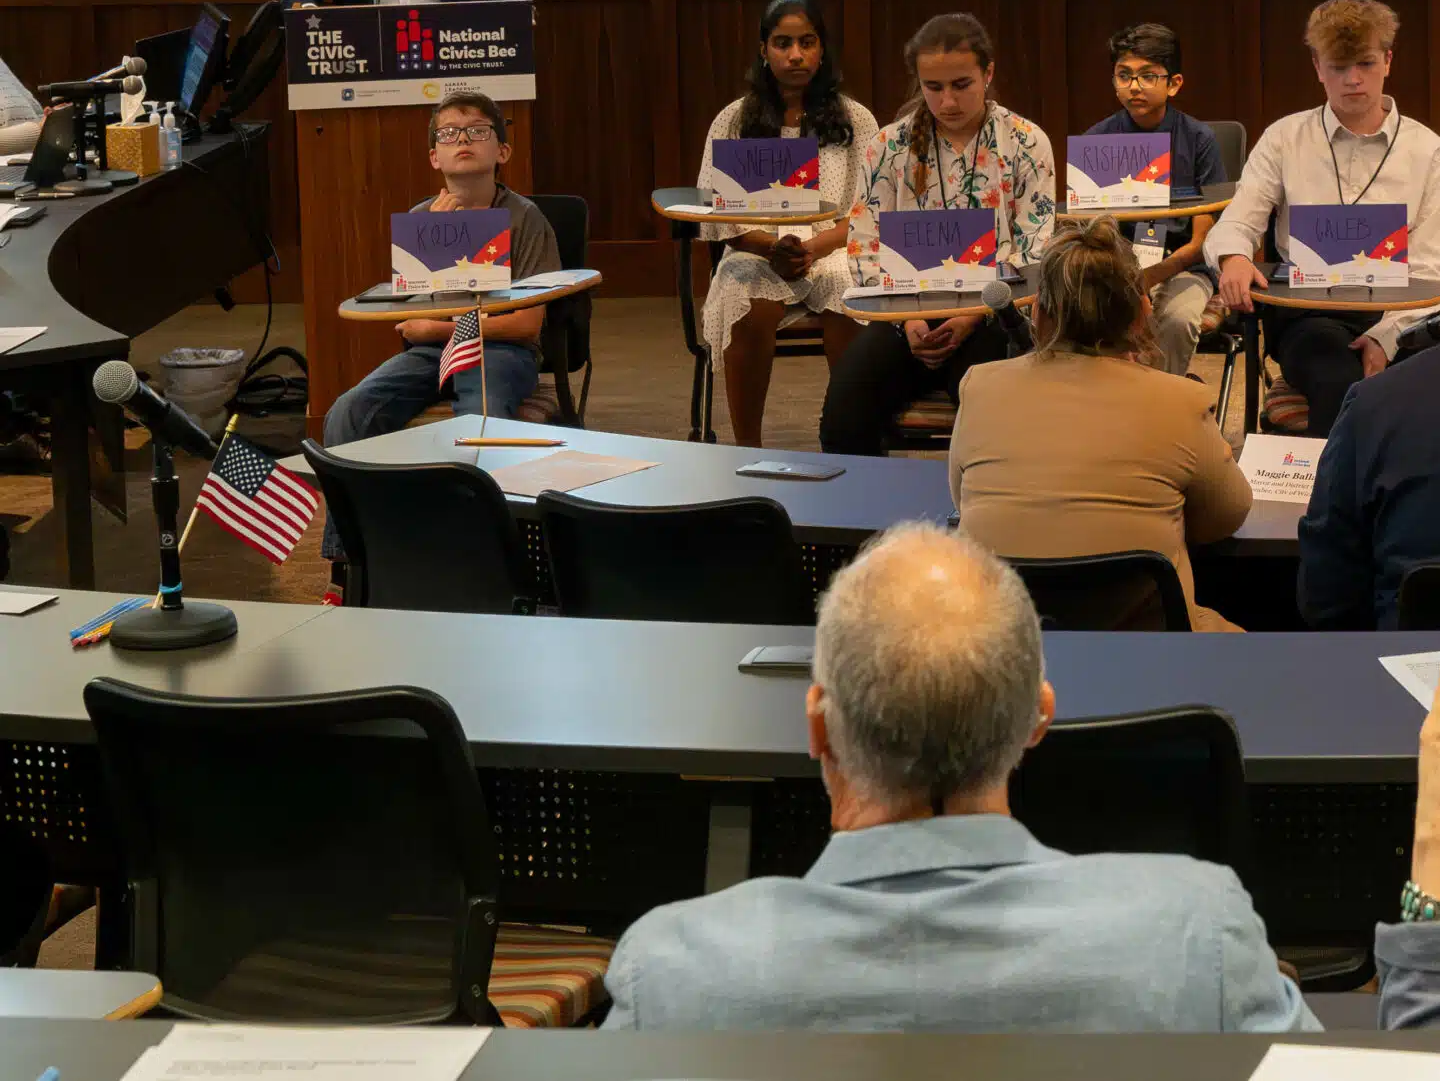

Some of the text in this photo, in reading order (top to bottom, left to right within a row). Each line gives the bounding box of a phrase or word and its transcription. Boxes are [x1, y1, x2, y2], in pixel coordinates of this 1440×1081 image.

[306, 30, 343, 45] THE
[439, 27, 505, 43] National
[307, 45, 356, 60] CIVIC
[439, 45, 486, 60] Civics
[416, 221, 472, 250] KODA
[903, 218, 961, 248] ELENA
[1315, 214, 1372, 243] CALEB
[1256, 469, 1291, 480] Maggie
